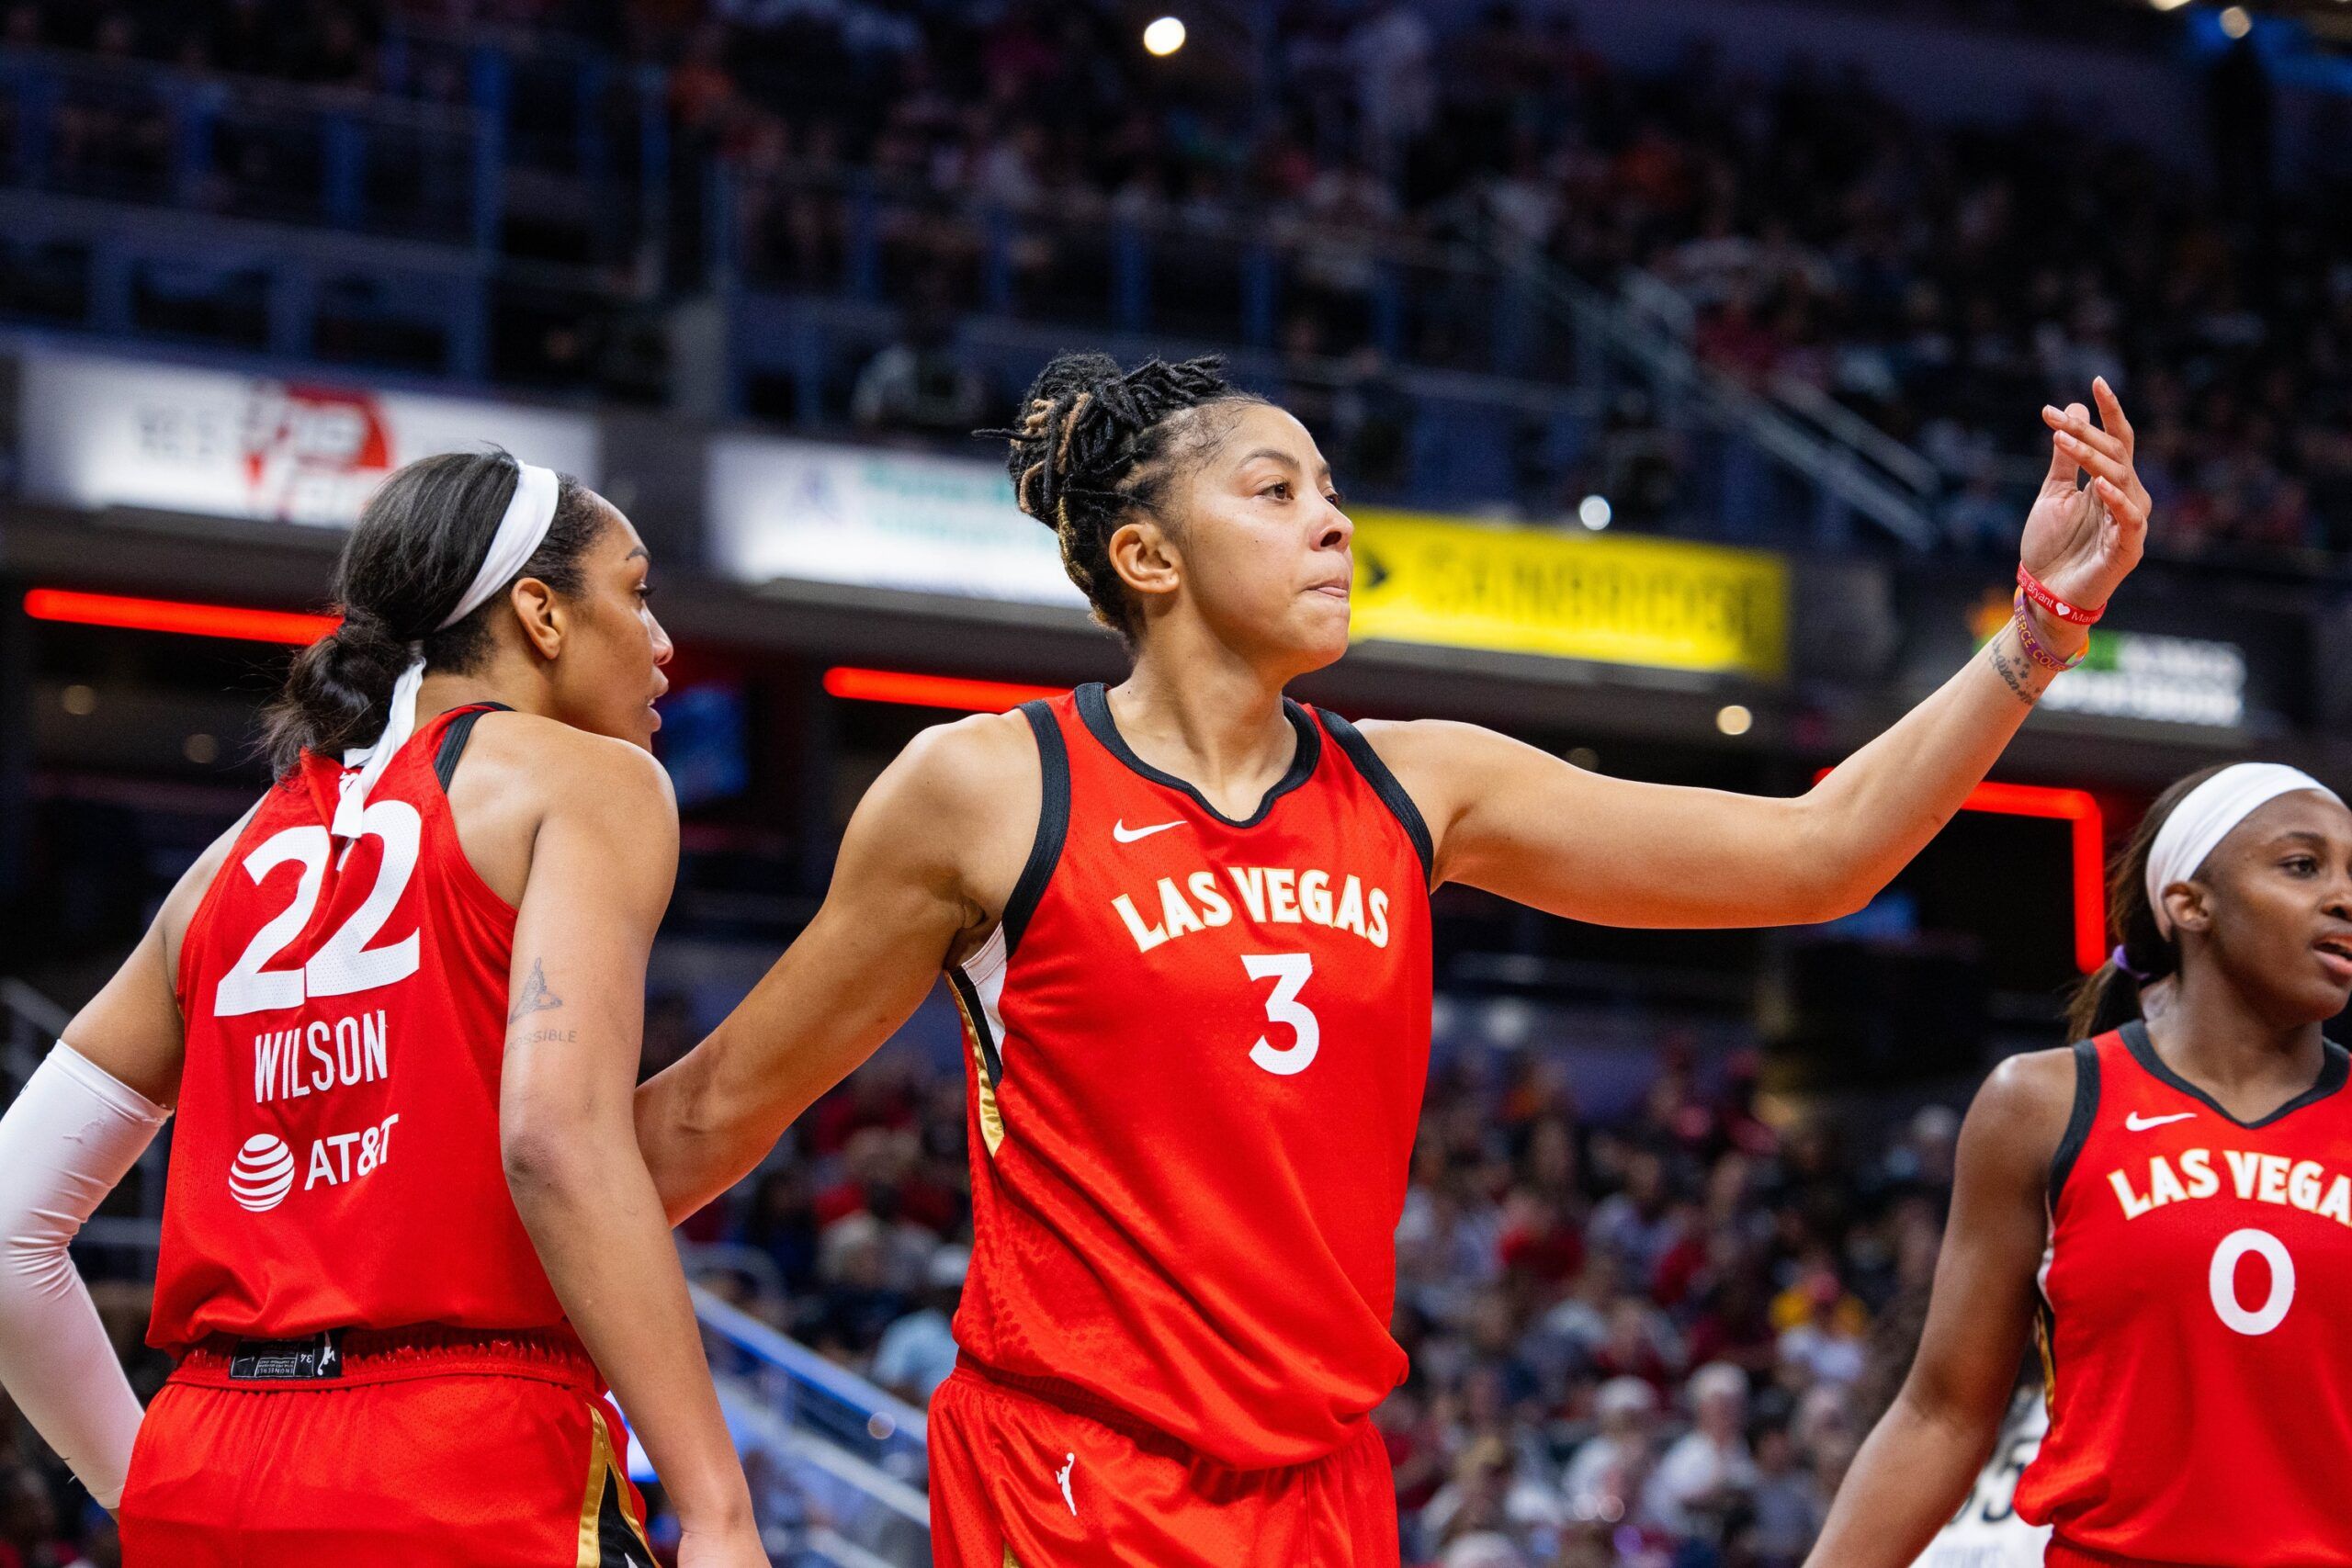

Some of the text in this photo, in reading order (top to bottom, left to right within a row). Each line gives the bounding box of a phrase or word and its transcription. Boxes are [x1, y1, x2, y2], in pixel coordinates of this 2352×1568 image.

[2015, 605, 2036, 649] FIERCE
[2028, 581, 2054, 608] Bryant
[214, 799, 423, 1017] 22
[1111, 866, 1389, 953] LAS VEGAS
[254, 1010, 389, 1103] WILSON
[1240, 953, 1320, 1076] 3
[304, 1113, 400, 1191] AT&T
[2107, 1147, 2221, 1221] LAS
[2208, 1227, 2296, 1337] 0
